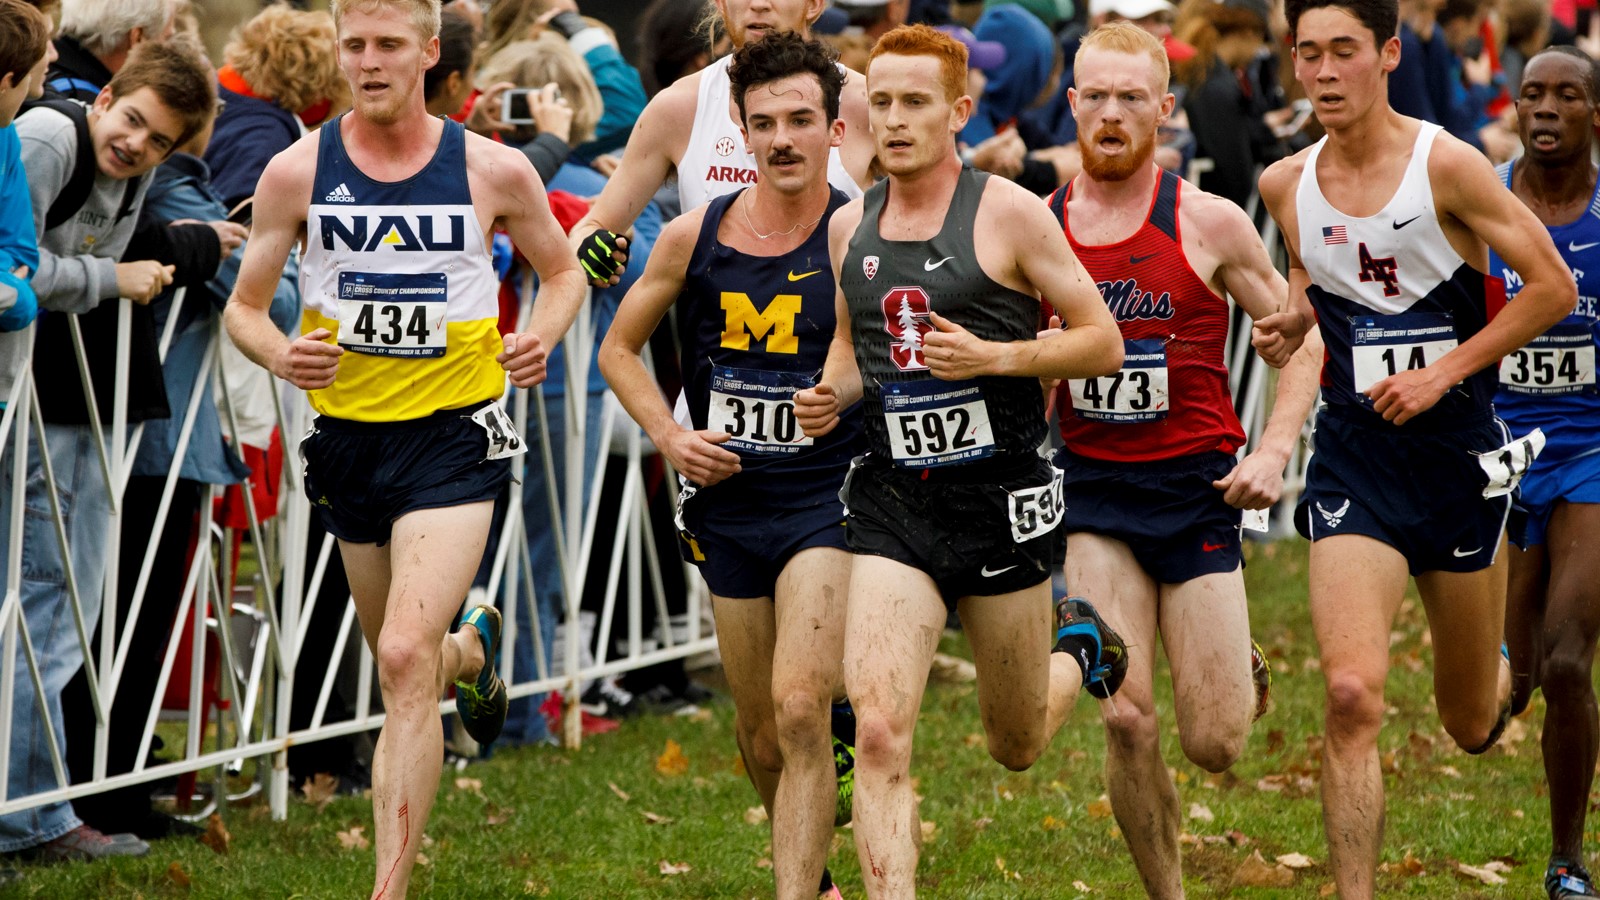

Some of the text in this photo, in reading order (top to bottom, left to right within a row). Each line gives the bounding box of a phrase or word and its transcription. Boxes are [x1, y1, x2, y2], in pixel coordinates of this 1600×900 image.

[716, 137, 735, 156] SEC
[325, 194, 355, 202] adidas
[318, 215, 465, 252] NAU
[1358, 241, 1401, 297] AF
[354, 286, 373, 294] CROSS
[399, 287, 445, 295] CHAMPIONSHIPS
[1096, 278, 1176, 322] Miss
[353, 304, 430, 345] 434
[720, 291, 802, 354] M
[1407, 325, 1453, 336] CHAMPIONSHIPS
[1549, 333, 1592, 343] CHAMPIONSHIPS
[1124, 353, 1165, 361] HAMPIONSHIPS
[1510, 350, 1580, 385] 354
[723, 382, 742, 390] CROSS
[742, 383, 767, 392] COUNTRY
[893, 397, 909, 405] CROSS
[909, 394, 933, 404] COUNTRY
[933, 386, 979, 401] CHAMPIONSHIPS
[1083, 371, 1151, 411] 473
[724, 397, 796, 443] 310
[899, 407, 977, 456] 592
